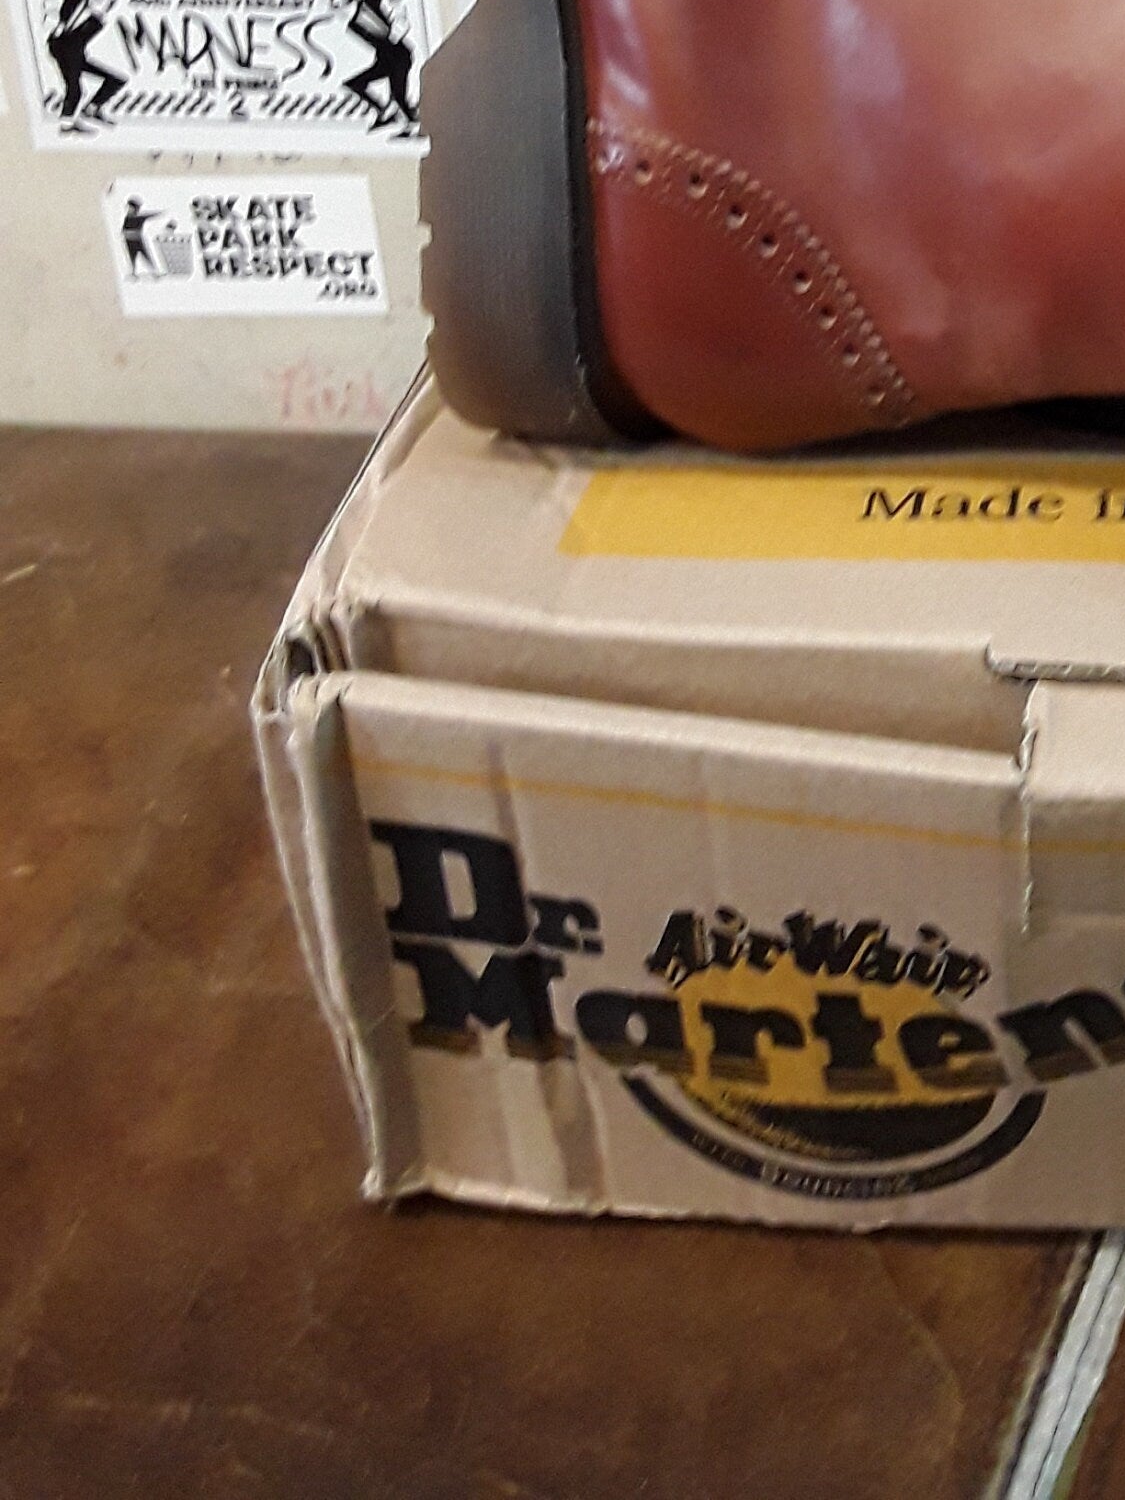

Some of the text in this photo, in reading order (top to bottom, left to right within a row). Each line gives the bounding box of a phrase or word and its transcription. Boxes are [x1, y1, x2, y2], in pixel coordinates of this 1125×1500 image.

[117, 11, 336, 80] MADNESS
[190, 194, 317, 222] SKATE
[197, 225, 303, 248] PARK
[202, 250, 375, 278] RESPECT
[859, 486, 1064, 522] Made
[645, 906, 992, 1002] AirWair
